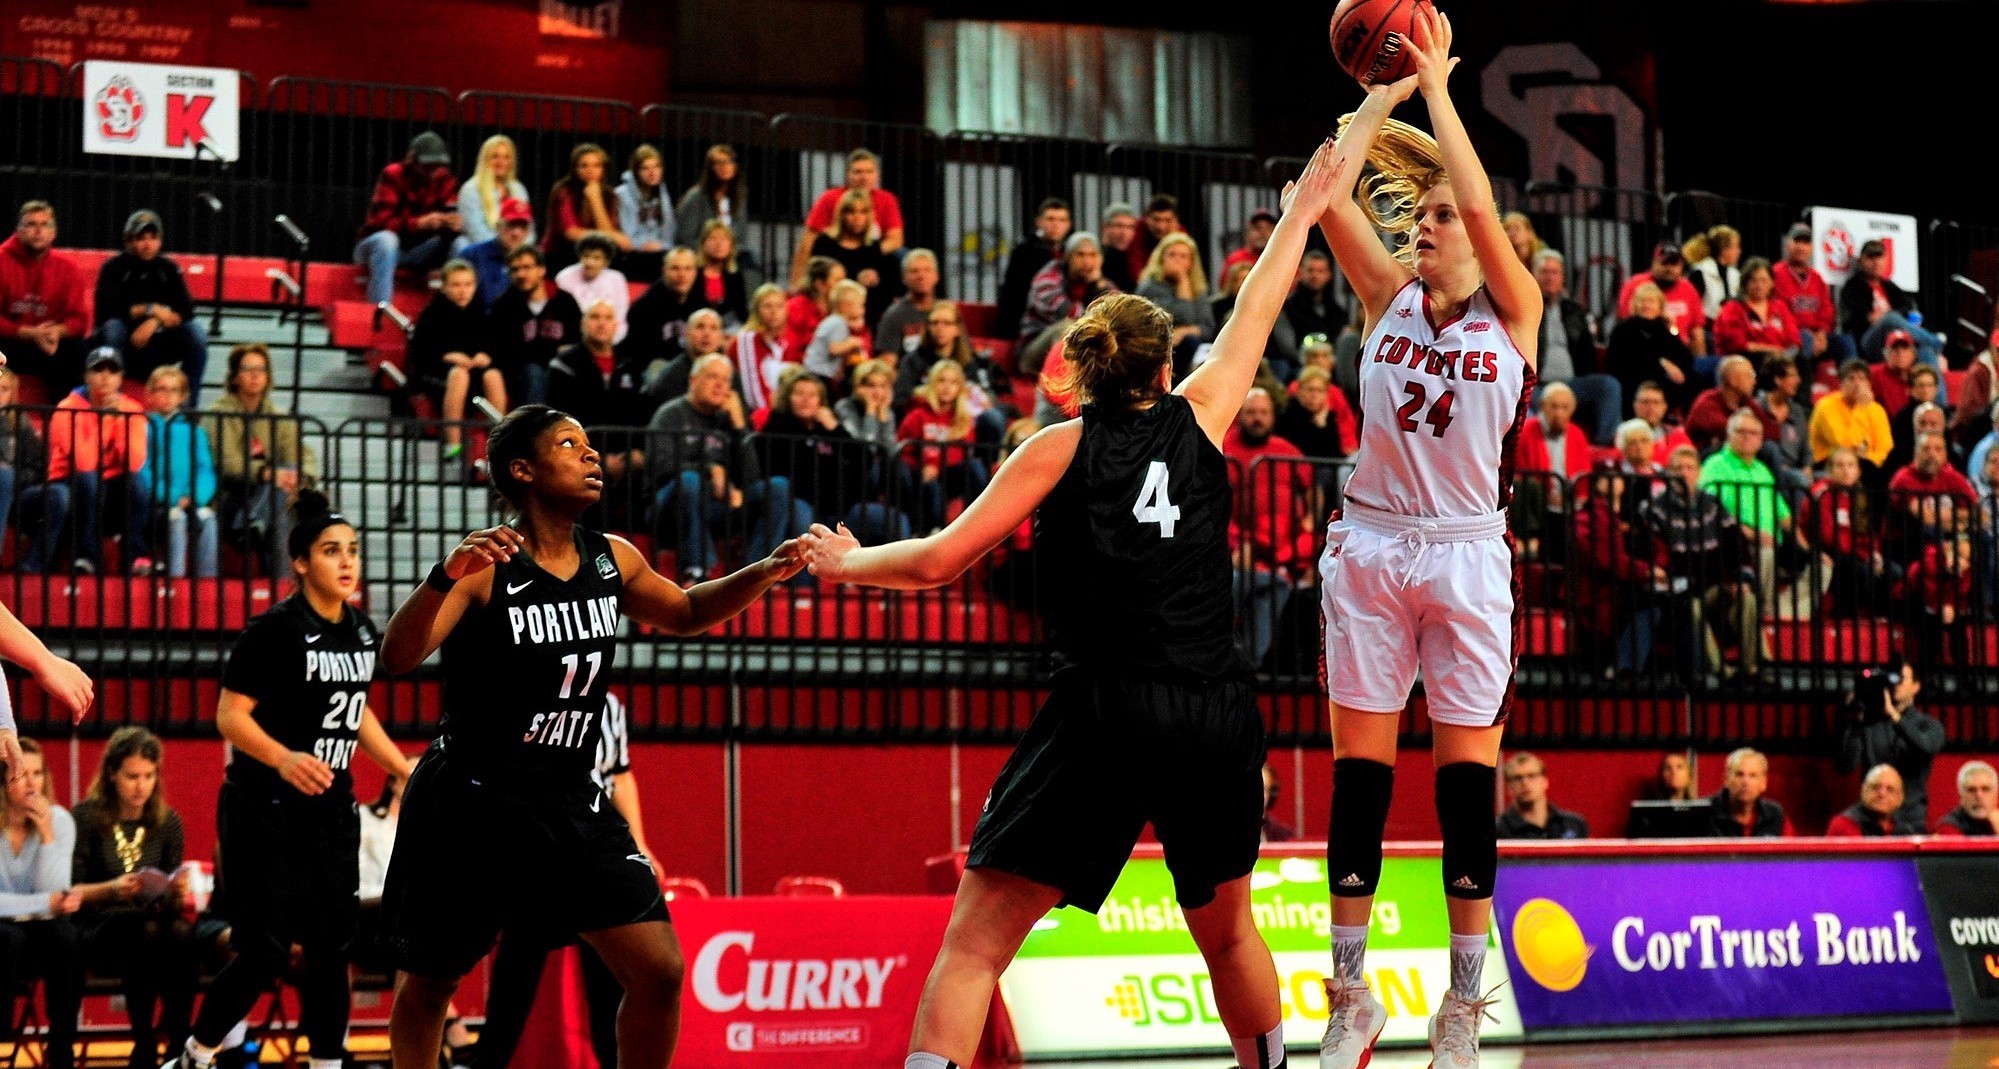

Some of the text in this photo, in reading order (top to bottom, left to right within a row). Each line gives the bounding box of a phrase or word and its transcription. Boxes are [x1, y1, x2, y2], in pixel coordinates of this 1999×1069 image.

[166, 93, 215, 148] K
[1374, 334, 1498, 383] COYOTES
[1397, 380, 1455, 438] 24
[1132, 461, 1180, 538] 4
[559, 651, 602, 699] 11
[322, 690, 367, 731] 20
[314, 737, 359, 770] STAT
[1612, 914, 1804, 973] CorTrust
[1812, 910, 1922, 966] Bank
